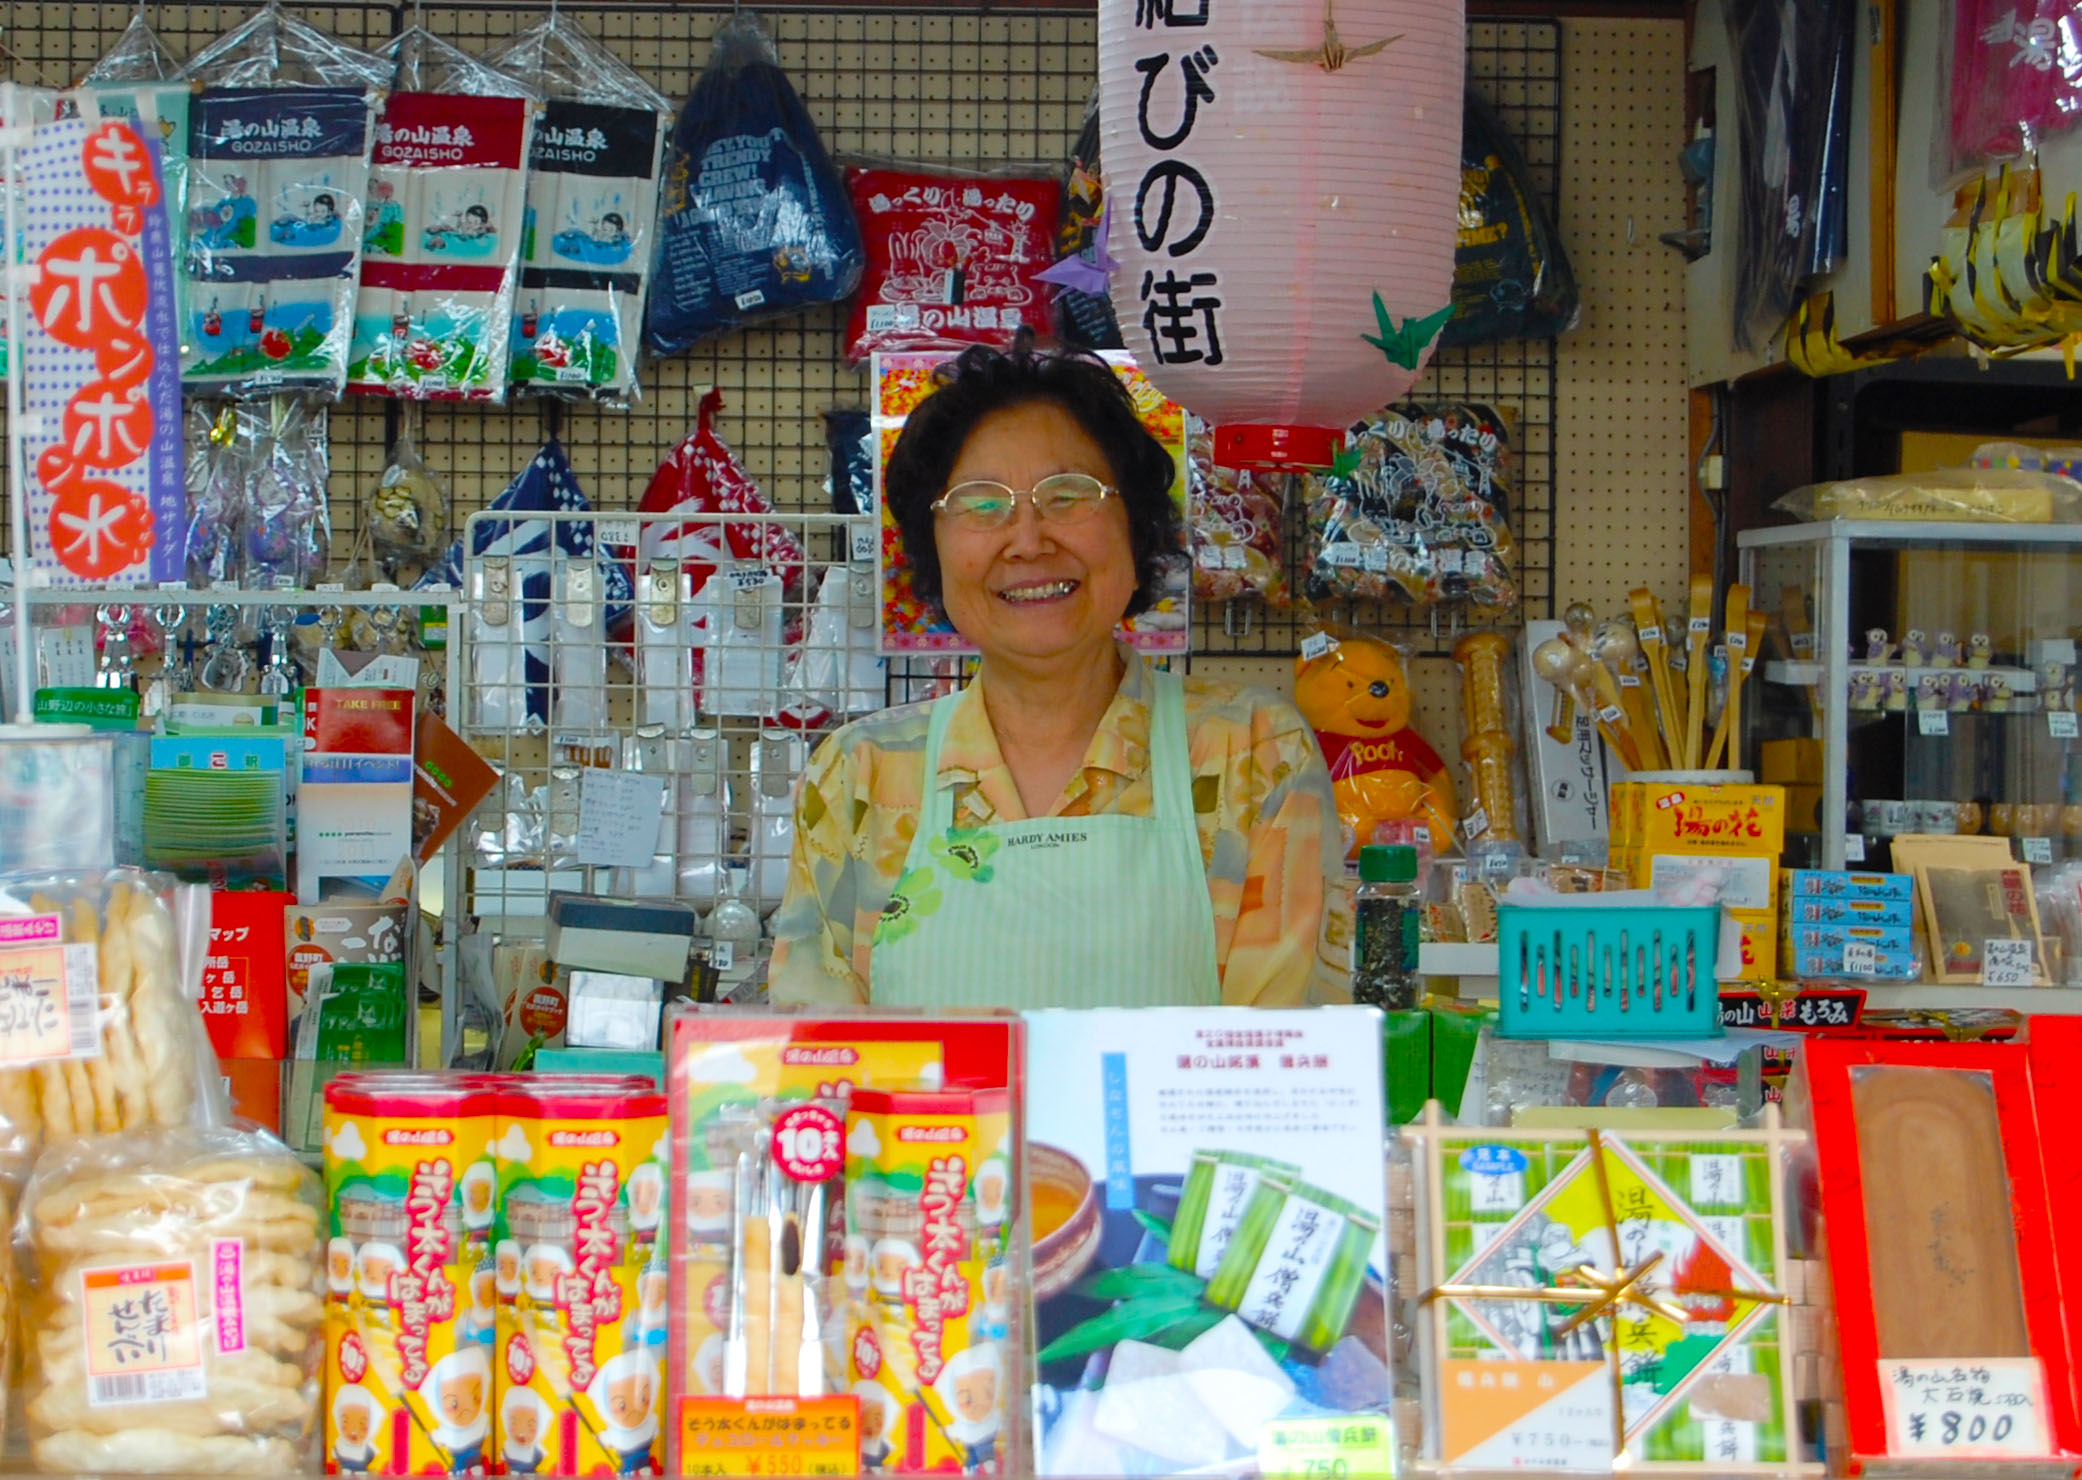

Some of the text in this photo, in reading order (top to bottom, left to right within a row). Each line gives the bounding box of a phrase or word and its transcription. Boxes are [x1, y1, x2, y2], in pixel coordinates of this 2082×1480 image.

[221, 118, 324, 139] 湯の山温泉
[232, 140, 314, 153] GOZAISHO
[381, 147, 464, 160] GOZAISHO
[337, 700, 400, 711] TAKE FREE
[1673, 806, 1763, 837] 湯の花
[1007, 831, 1088, 848] HARDY AMIES
[210, 926, 249, 941] マップ
[1477, 1147, 1511, 1161] 見本
[688, 1416, 851, 1432] そう太くんがはまってる
[1909, 1410, 2013, 1445] ¥800
